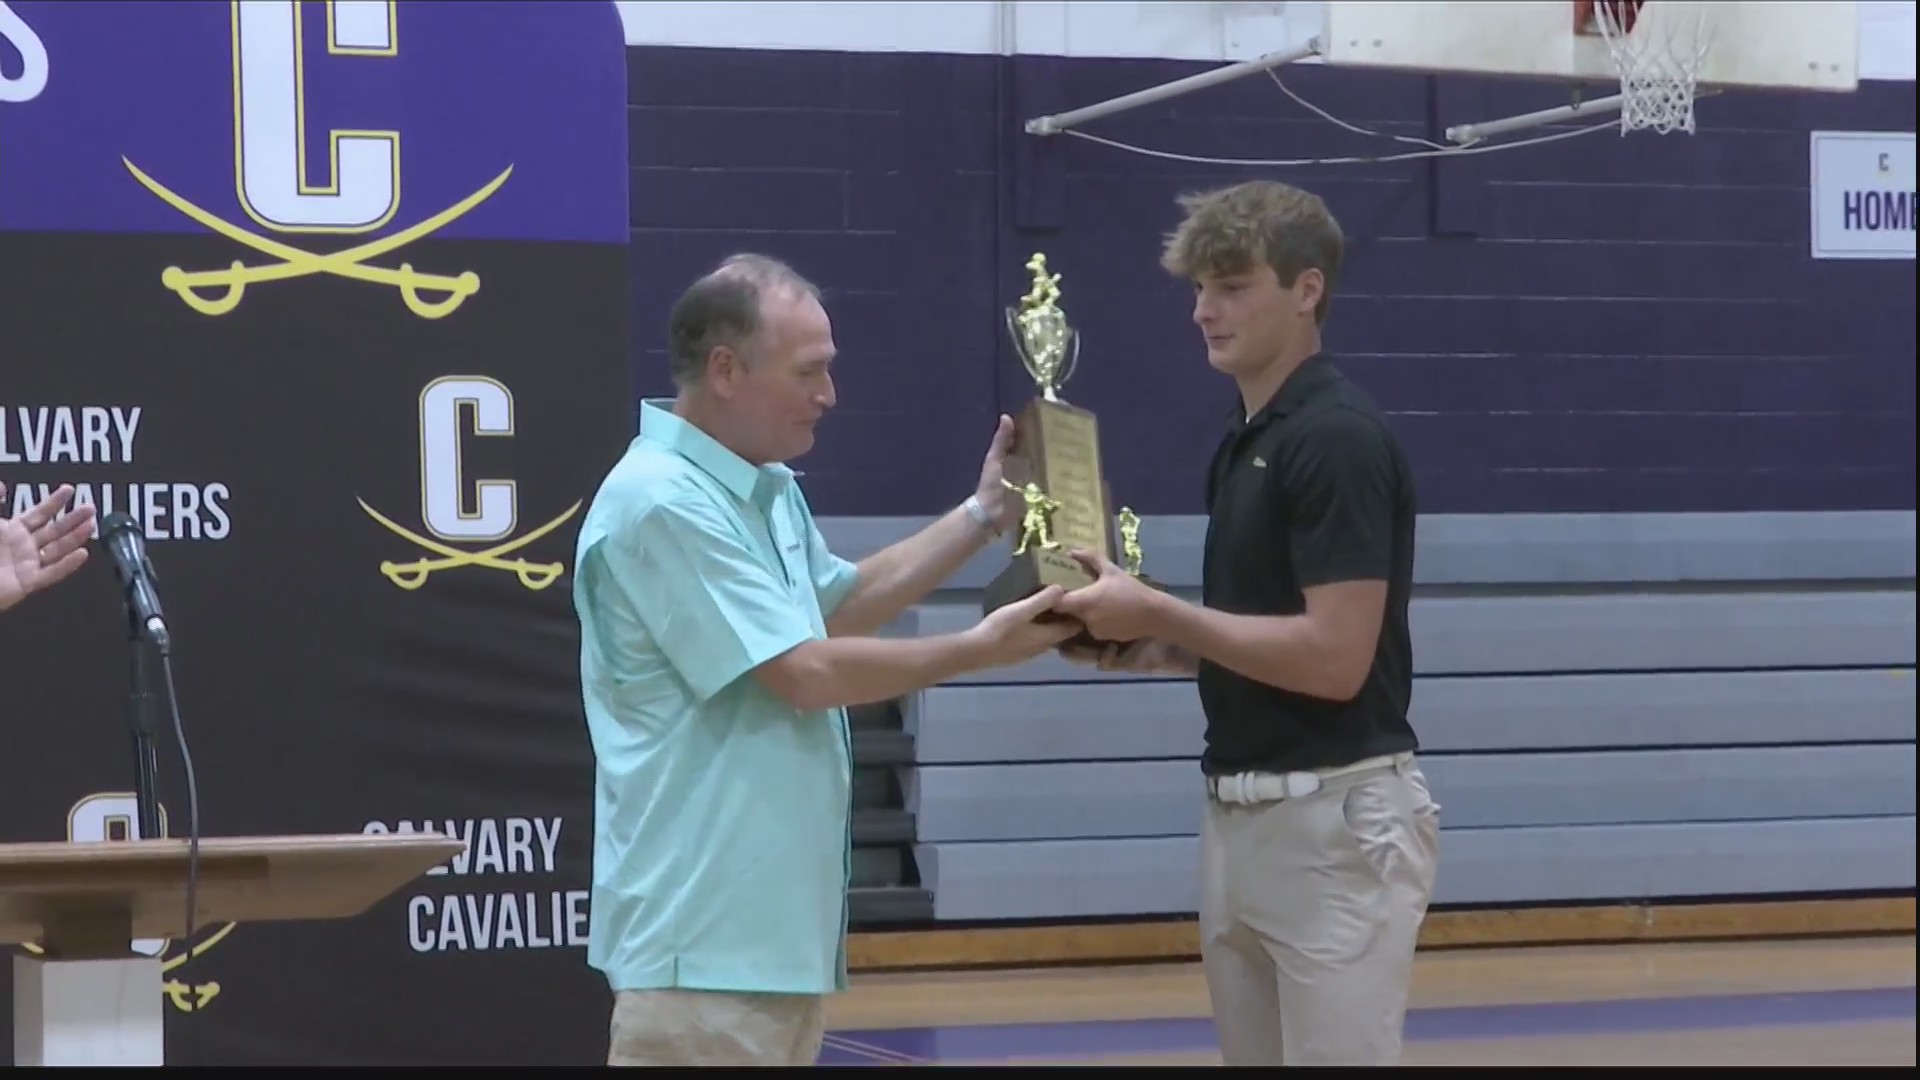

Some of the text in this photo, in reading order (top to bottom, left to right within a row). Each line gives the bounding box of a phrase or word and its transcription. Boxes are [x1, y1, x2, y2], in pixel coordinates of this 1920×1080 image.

[231, 2, 401, 234] C
[419, 375, 518, 541] C
[363, 817, 563, 875] VARY
